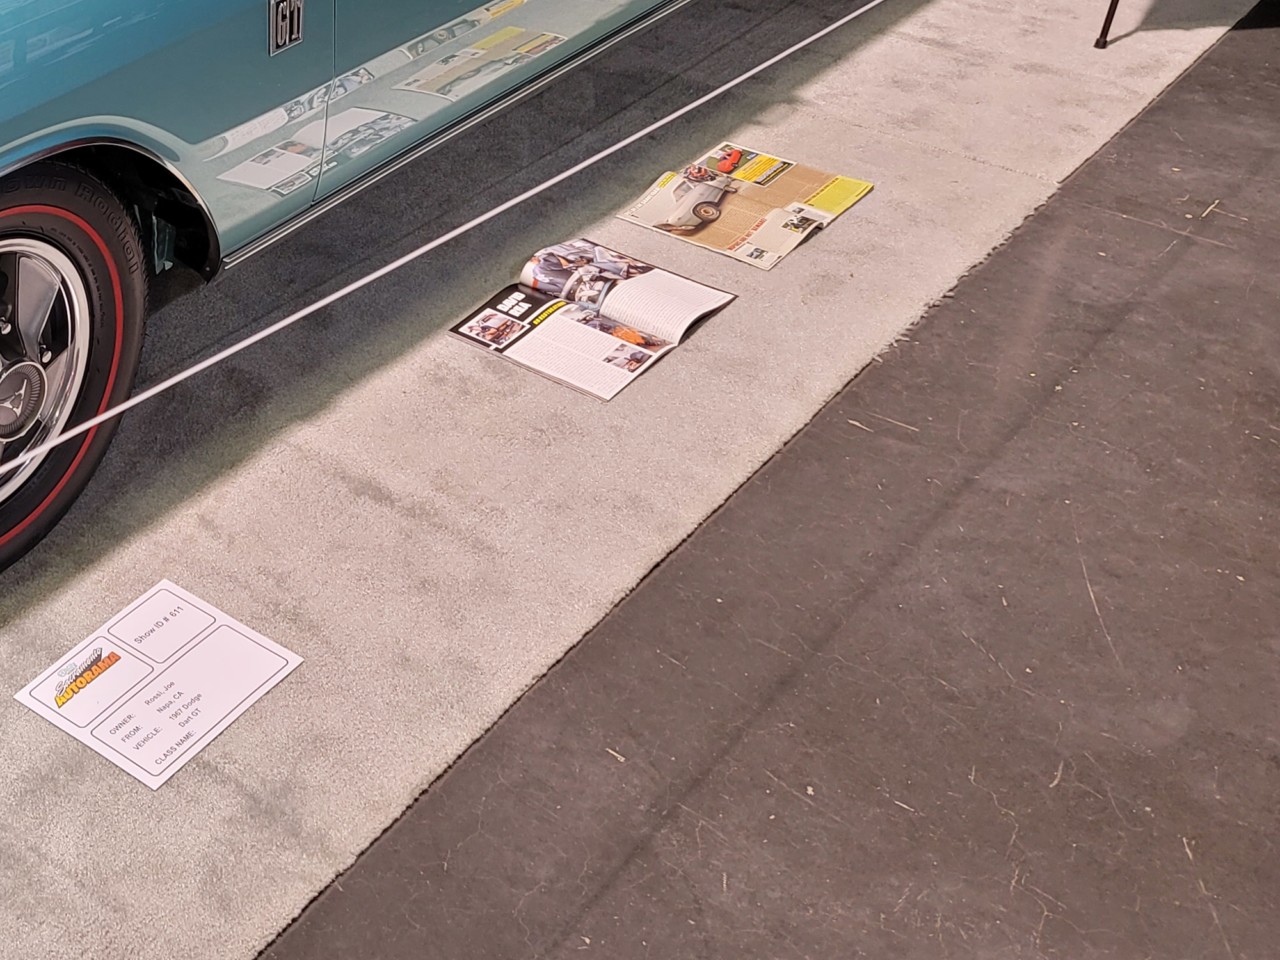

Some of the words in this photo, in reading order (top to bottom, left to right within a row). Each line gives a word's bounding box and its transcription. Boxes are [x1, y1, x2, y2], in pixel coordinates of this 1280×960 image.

[133, 628, 156, 645] Show
[154, 620, 165, 629] ID
[169, 606, 184, 618] 611
[54, 651, 122, 709] AUTORAMA
[55, 647, 103, 696] Sacramento
[109, 713, 136, 735] OWNER:
[163, 681, 175, 692] Joe
[120, 724, 143, 743] FROM:
[156, 700, 176, 714] Napa,
[172, 690, 184, 700] CA
[132, 726, 163, 751] VEHICLE:
[168, 708, 184, 721] 1967
[182, 693, 202, 710] Dodge
[178, 715, 193, 728] Dart
[191, 707, 202, 718] GT
[154, 746, 177, 765] CLASS
[174, 730, 197, 748] NAME:
